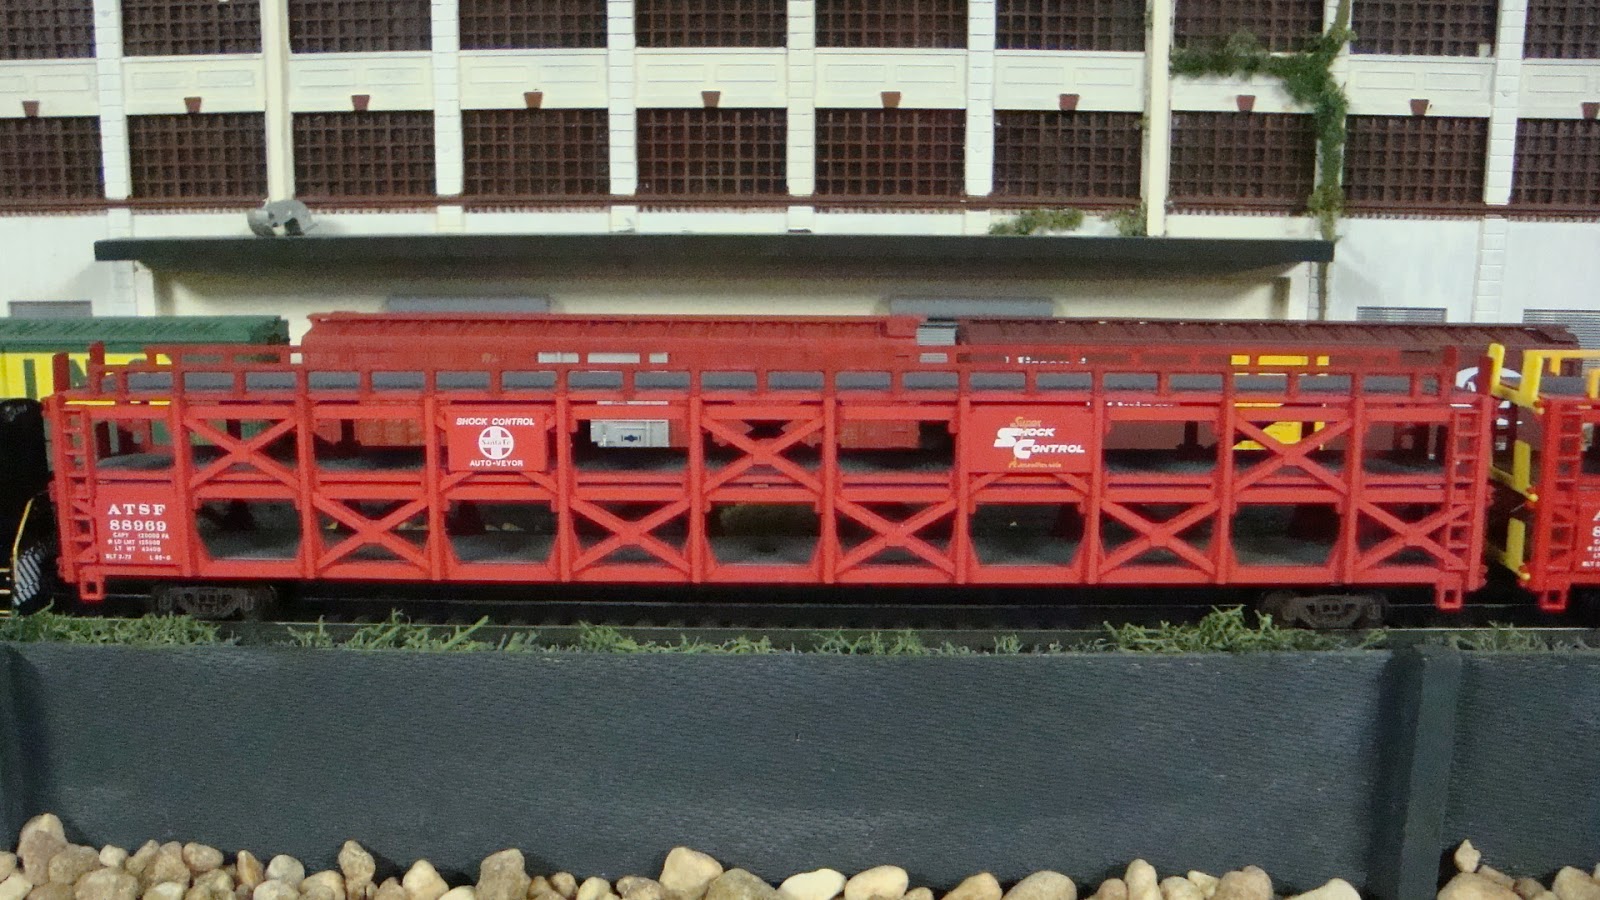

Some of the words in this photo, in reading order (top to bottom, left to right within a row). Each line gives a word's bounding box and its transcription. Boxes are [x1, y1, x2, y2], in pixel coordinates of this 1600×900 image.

[456, 417, 487, 426] SHOCK
[492, 417, 534, 426] CONTROL
[108, 504, 166, 516] ATSF
[110, 520, 166, 532] 88969
